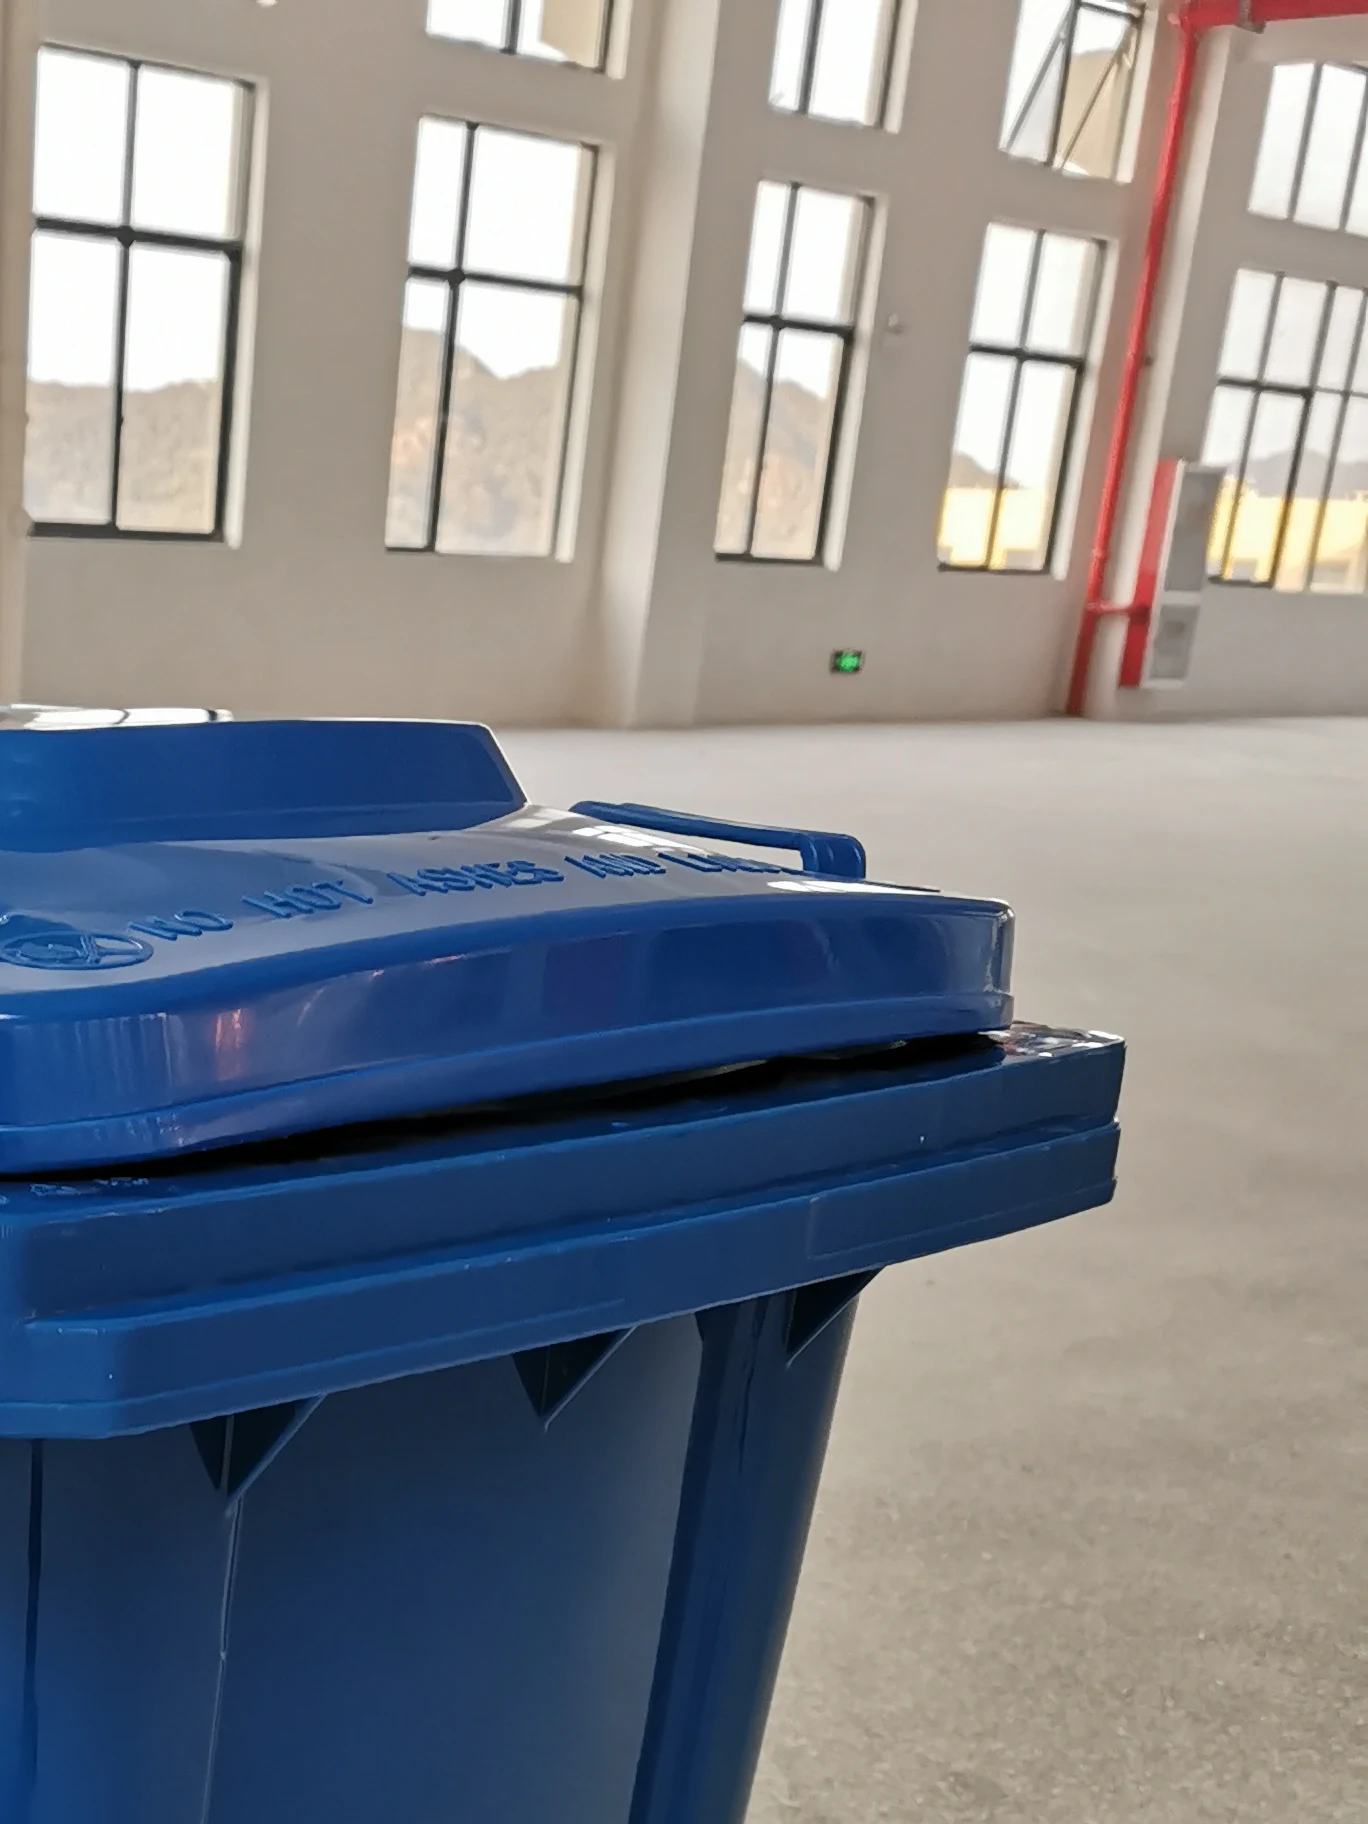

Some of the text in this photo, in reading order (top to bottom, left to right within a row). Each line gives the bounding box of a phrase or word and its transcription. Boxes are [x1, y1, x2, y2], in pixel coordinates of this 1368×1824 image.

[128, 909, 234, 941] NO
[240, 879, 374, 919] HOT
[386, 859, 565, 897] ASHES
[563, 852, 667, 879] AND
